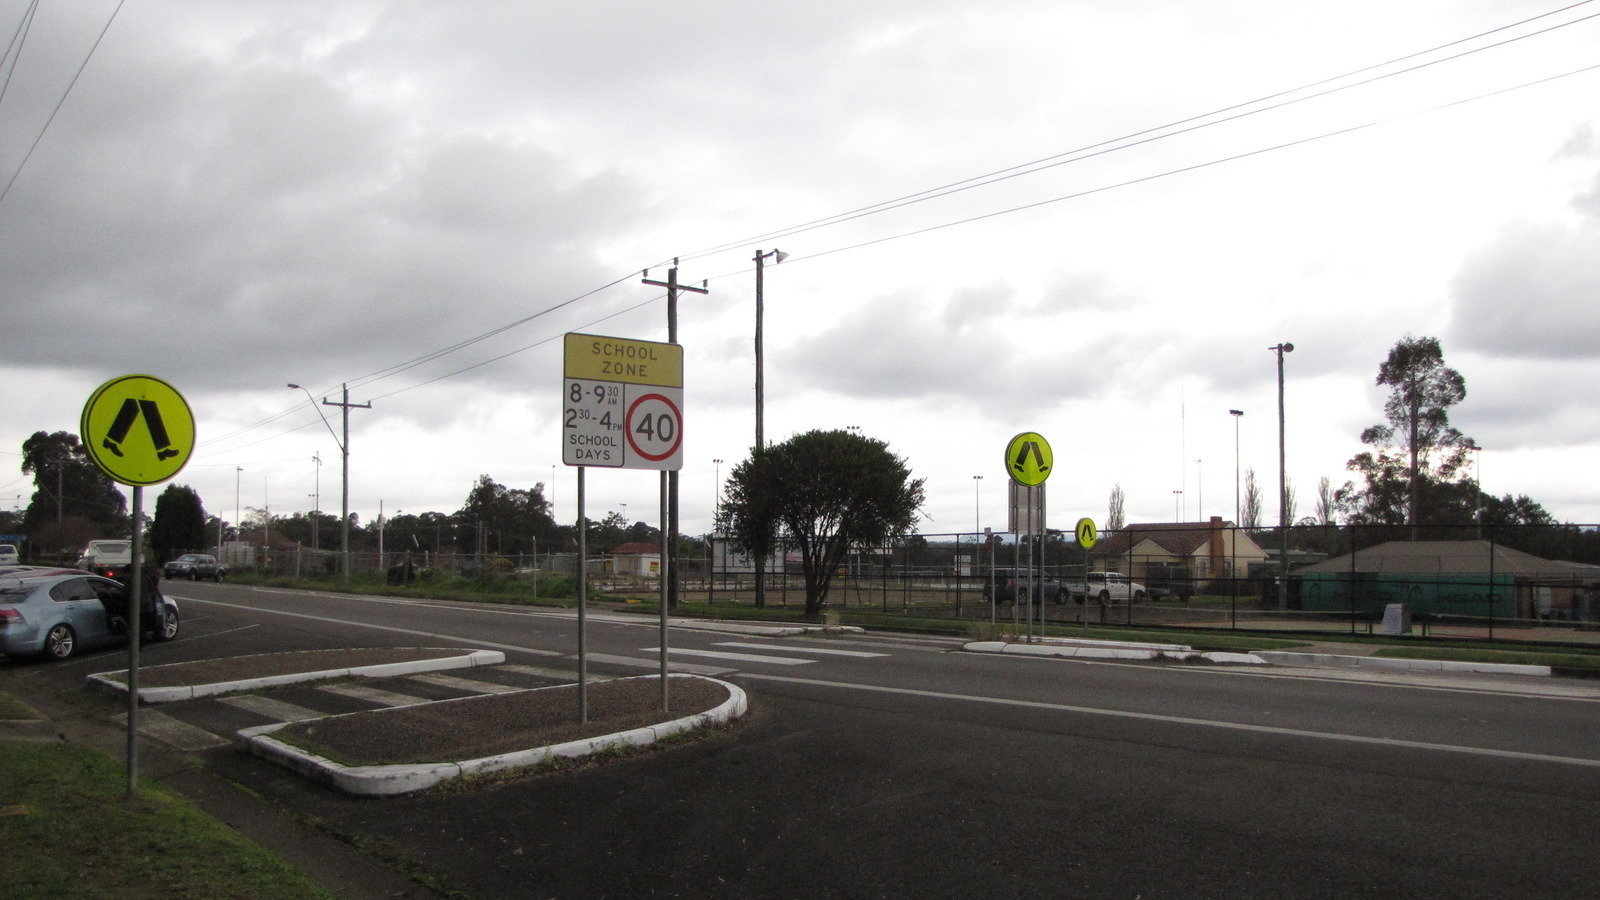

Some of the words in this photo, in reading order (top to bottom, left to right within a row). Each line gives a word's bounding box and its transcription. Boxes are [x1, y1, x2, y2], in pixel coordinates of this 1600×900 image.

[592, 342, 658, 361] SCHOOL
[602, 361, 648, 377] ZONE
[636, 413, 674, 442] 40
[570, 434, 617, 447] SCHOOL
[576, 448, 611, 460] DAYS
